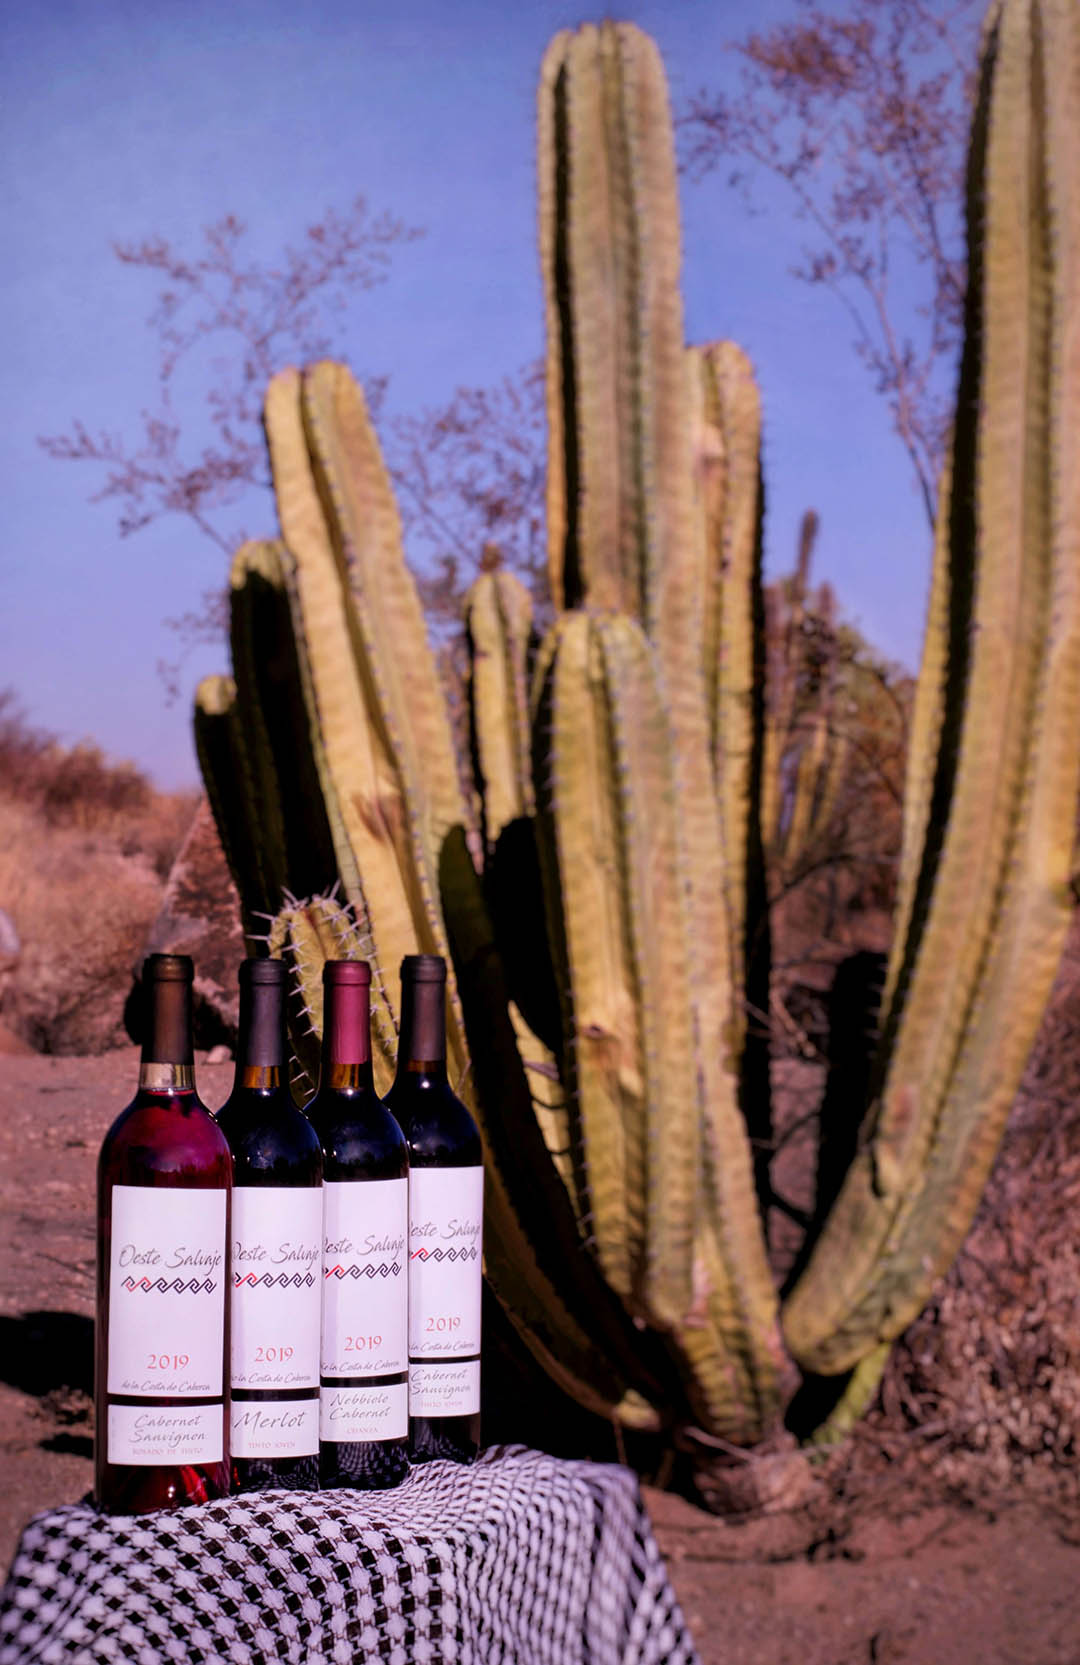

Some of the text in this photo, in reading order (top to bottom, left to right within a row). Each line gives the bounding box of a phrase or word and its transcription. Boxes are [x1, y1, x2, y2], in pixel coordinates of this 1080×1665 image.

[356, 1233, 404, 1261] Salvaje
[119, 1244, 221, 1277] Oeste Salvaje
[270, 1243, 320, 1271] Salvaje
[426, 1317, 461, 1332] 2019
[344, 1335, 383, 1351] 2019
[420, 1342, 442, 1353] Costa
[255, 1347, 294, 1362] 2019
[147, 1354, 190, 1371] 2019
[339, 1361, 362, 1373] Costa
[363, 1361, 373, 1371] de
[248, 1372, 272, 1384] Costa
[273, 1374, 283, 1383] de
[411, 1369, 467, 1382] Cabernet
[140, 1380, 165, 1392] Costa
[166, 1381, 177, 1391] de
[411, 1383, 471, 1399] Sauvignon
[134, 1414, 202, 1429] Cabernet
[329, 1407, 391, 1421] Cabernet
[233, 1411, 307, 1434] Merlot
[129, 1429, 206, 1448] Sauvignon
